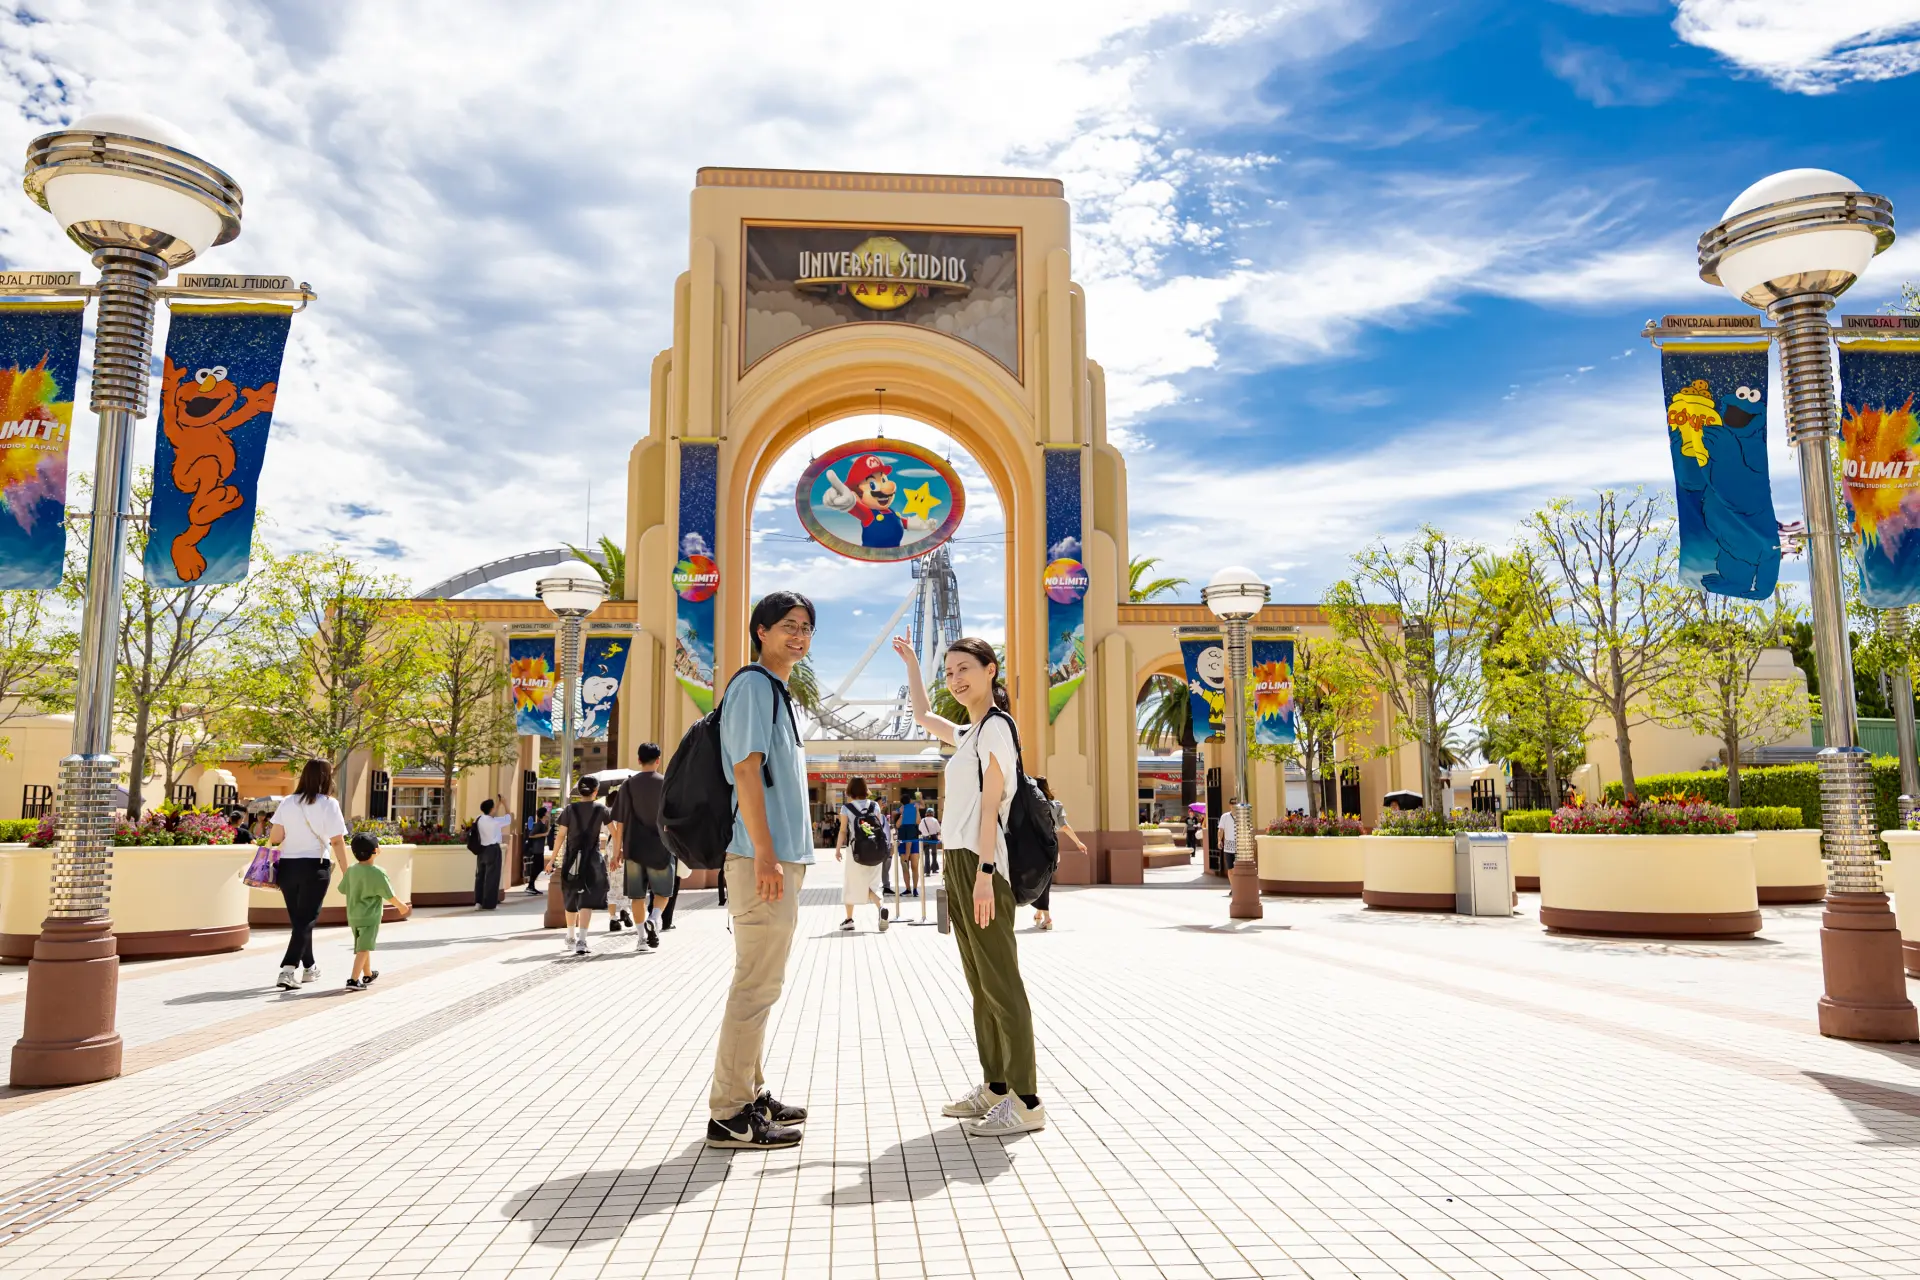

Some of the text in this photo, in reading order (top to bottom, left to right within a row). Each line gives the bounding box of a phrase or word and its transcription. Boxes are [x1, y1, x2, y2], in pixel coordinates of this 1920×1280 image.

[799, 251, 967, 282] UNIVERSAL STUDIOS
[0, 274, 74, 286] RSAL STUDIOS
[184, 277, 288, 290] UNIVERSAL STUDIOS
[837, 282, 930, 298] JAPAN
[1667, 318, 1755, 328] UNIVERSAL STUDIOS
[1848, 318, 1920, 328] UNIVERSAL STUD
[0, 419, 67, 442] IMIT!
[30, 443, 59, 451] JAPAN
[1843, 458, 1920, 479] NO LIMIT
[1894, 481, 1919, 489] JAPAN
[673, 574, 719, 583] NO LIMIT!
[1045, 577, 1088, 586] NO LIMIT!
[1255, 682, 1267, 690] NO
